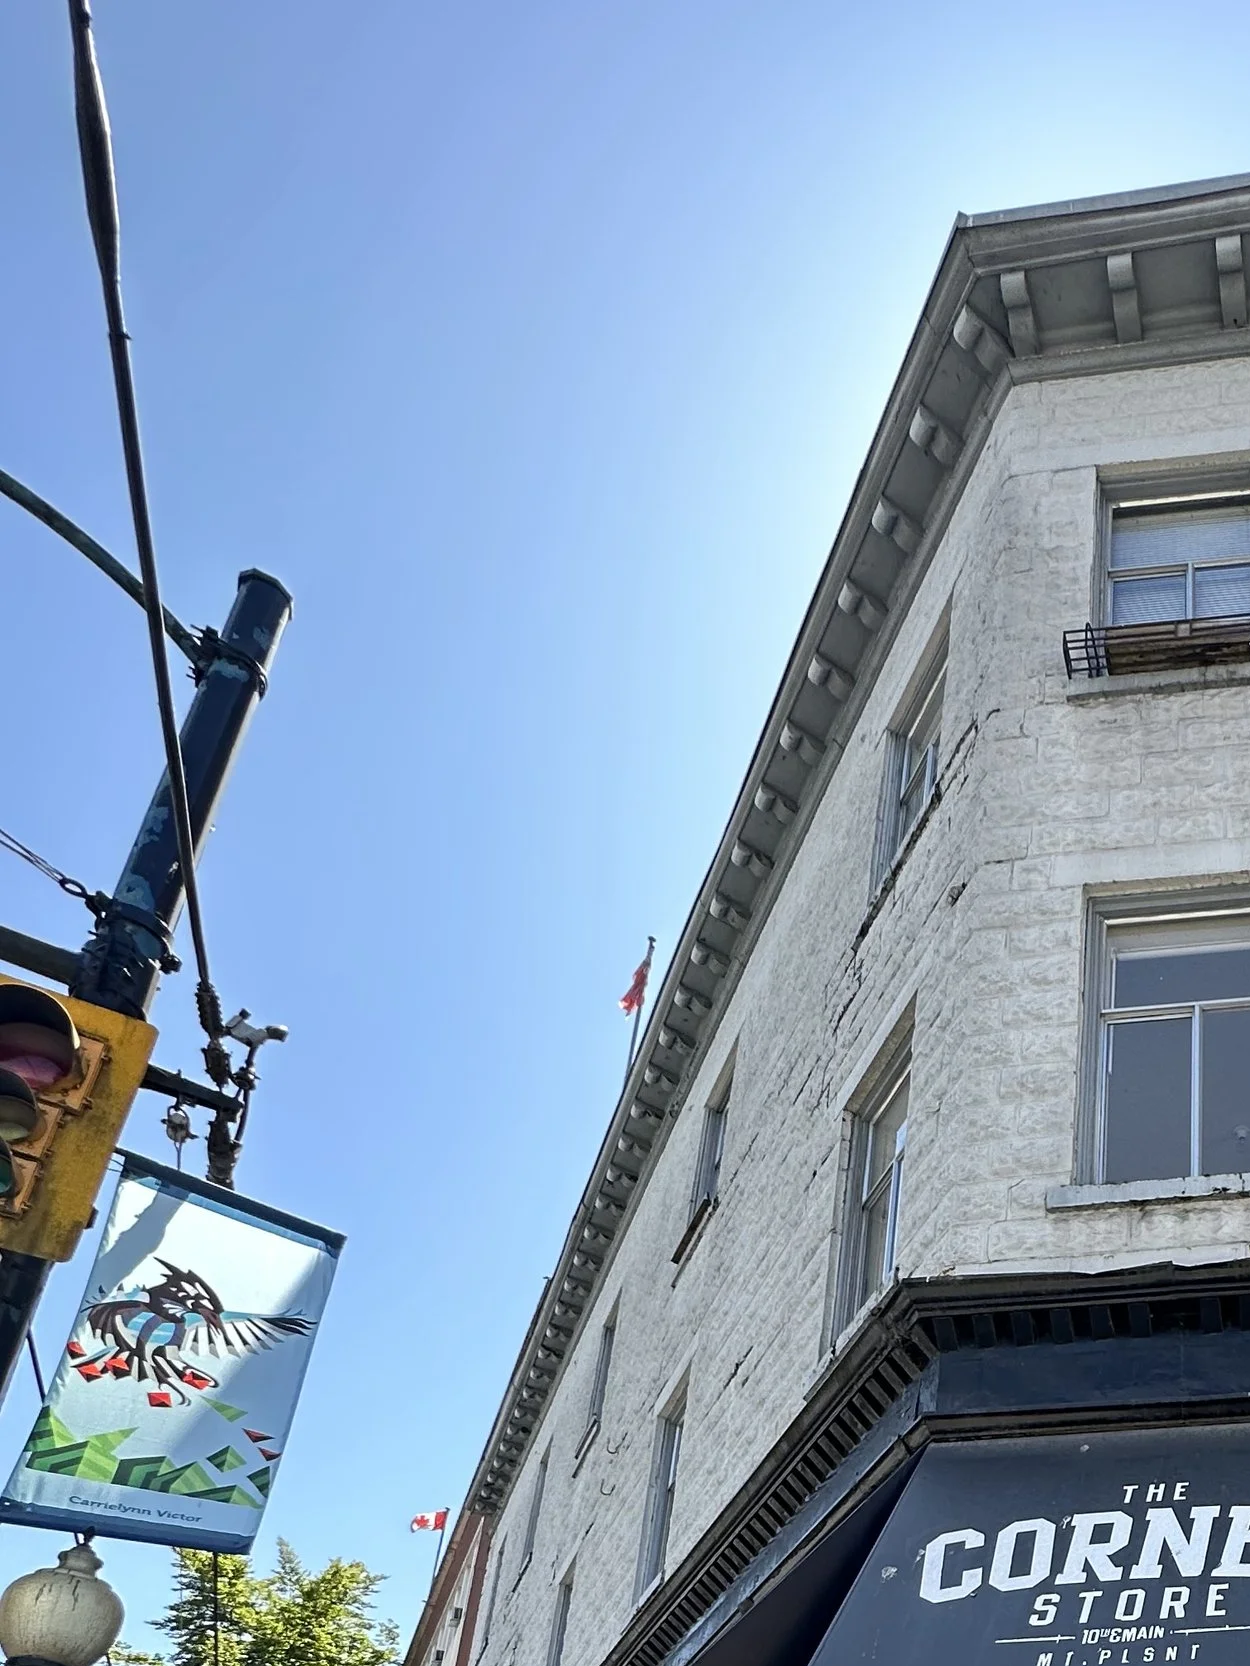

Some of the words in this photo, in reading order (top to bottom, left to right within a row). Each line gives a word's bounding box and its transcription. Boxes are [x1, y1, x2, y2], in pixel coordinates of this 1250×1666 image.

[1122, 1481, 1190, 1503] THE
[69, 1495, 151, 1515] Carrielynn
[156, 1509, 203, 1523] Victor
[1029, 1583, 1230, 1626] STORE
